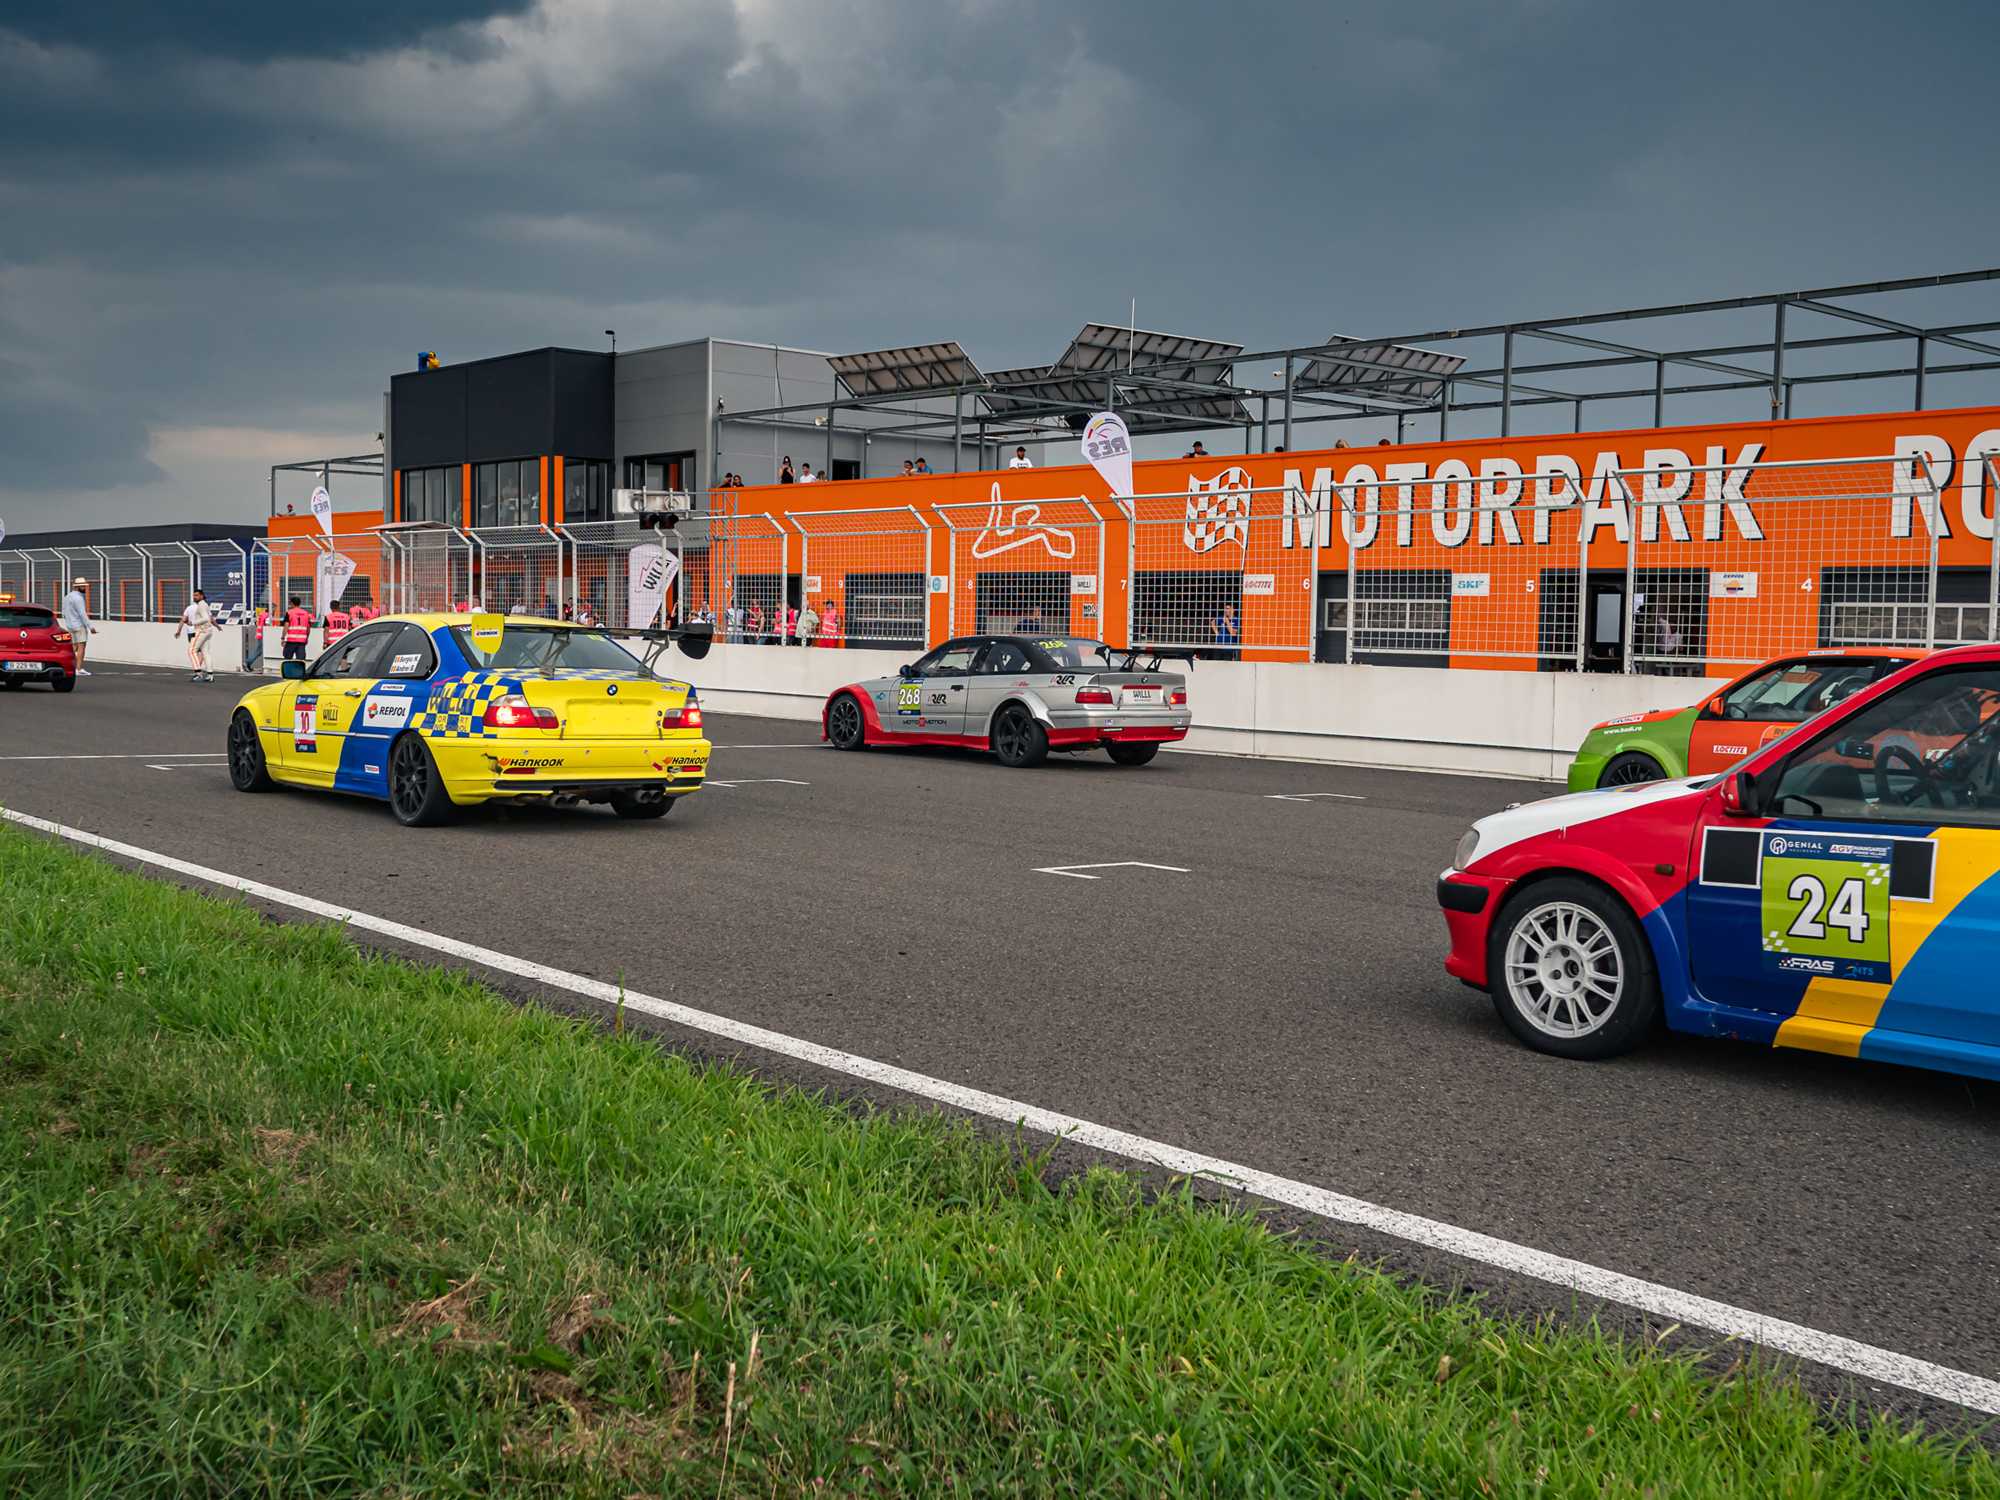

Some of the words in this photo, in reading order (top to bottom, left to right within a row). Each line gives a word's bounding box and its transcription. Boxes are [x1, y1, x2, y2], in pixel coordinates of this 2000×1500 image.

[1281, 443, 1767, 549] MOTORPARK
[967, 580, 974, 590] 8
[1120, 579, 1127, 591] 7
[1303, 578, 1311, 590] 6
[1526, 579, 1535, 592] 5
[1800, 577, 1813, 593] 4
[899, 688, 920, 705] 268
[380, 706, 406, 717] REPSOL
[300, 712, 310, 733] 10
[510, 758, 564, 767] HANKOOK
[1787, 841, 1824, 850] GENIAL
[1787, 873, 1870, 943] 24
[1790, 957, 1836, 971] FRAS
